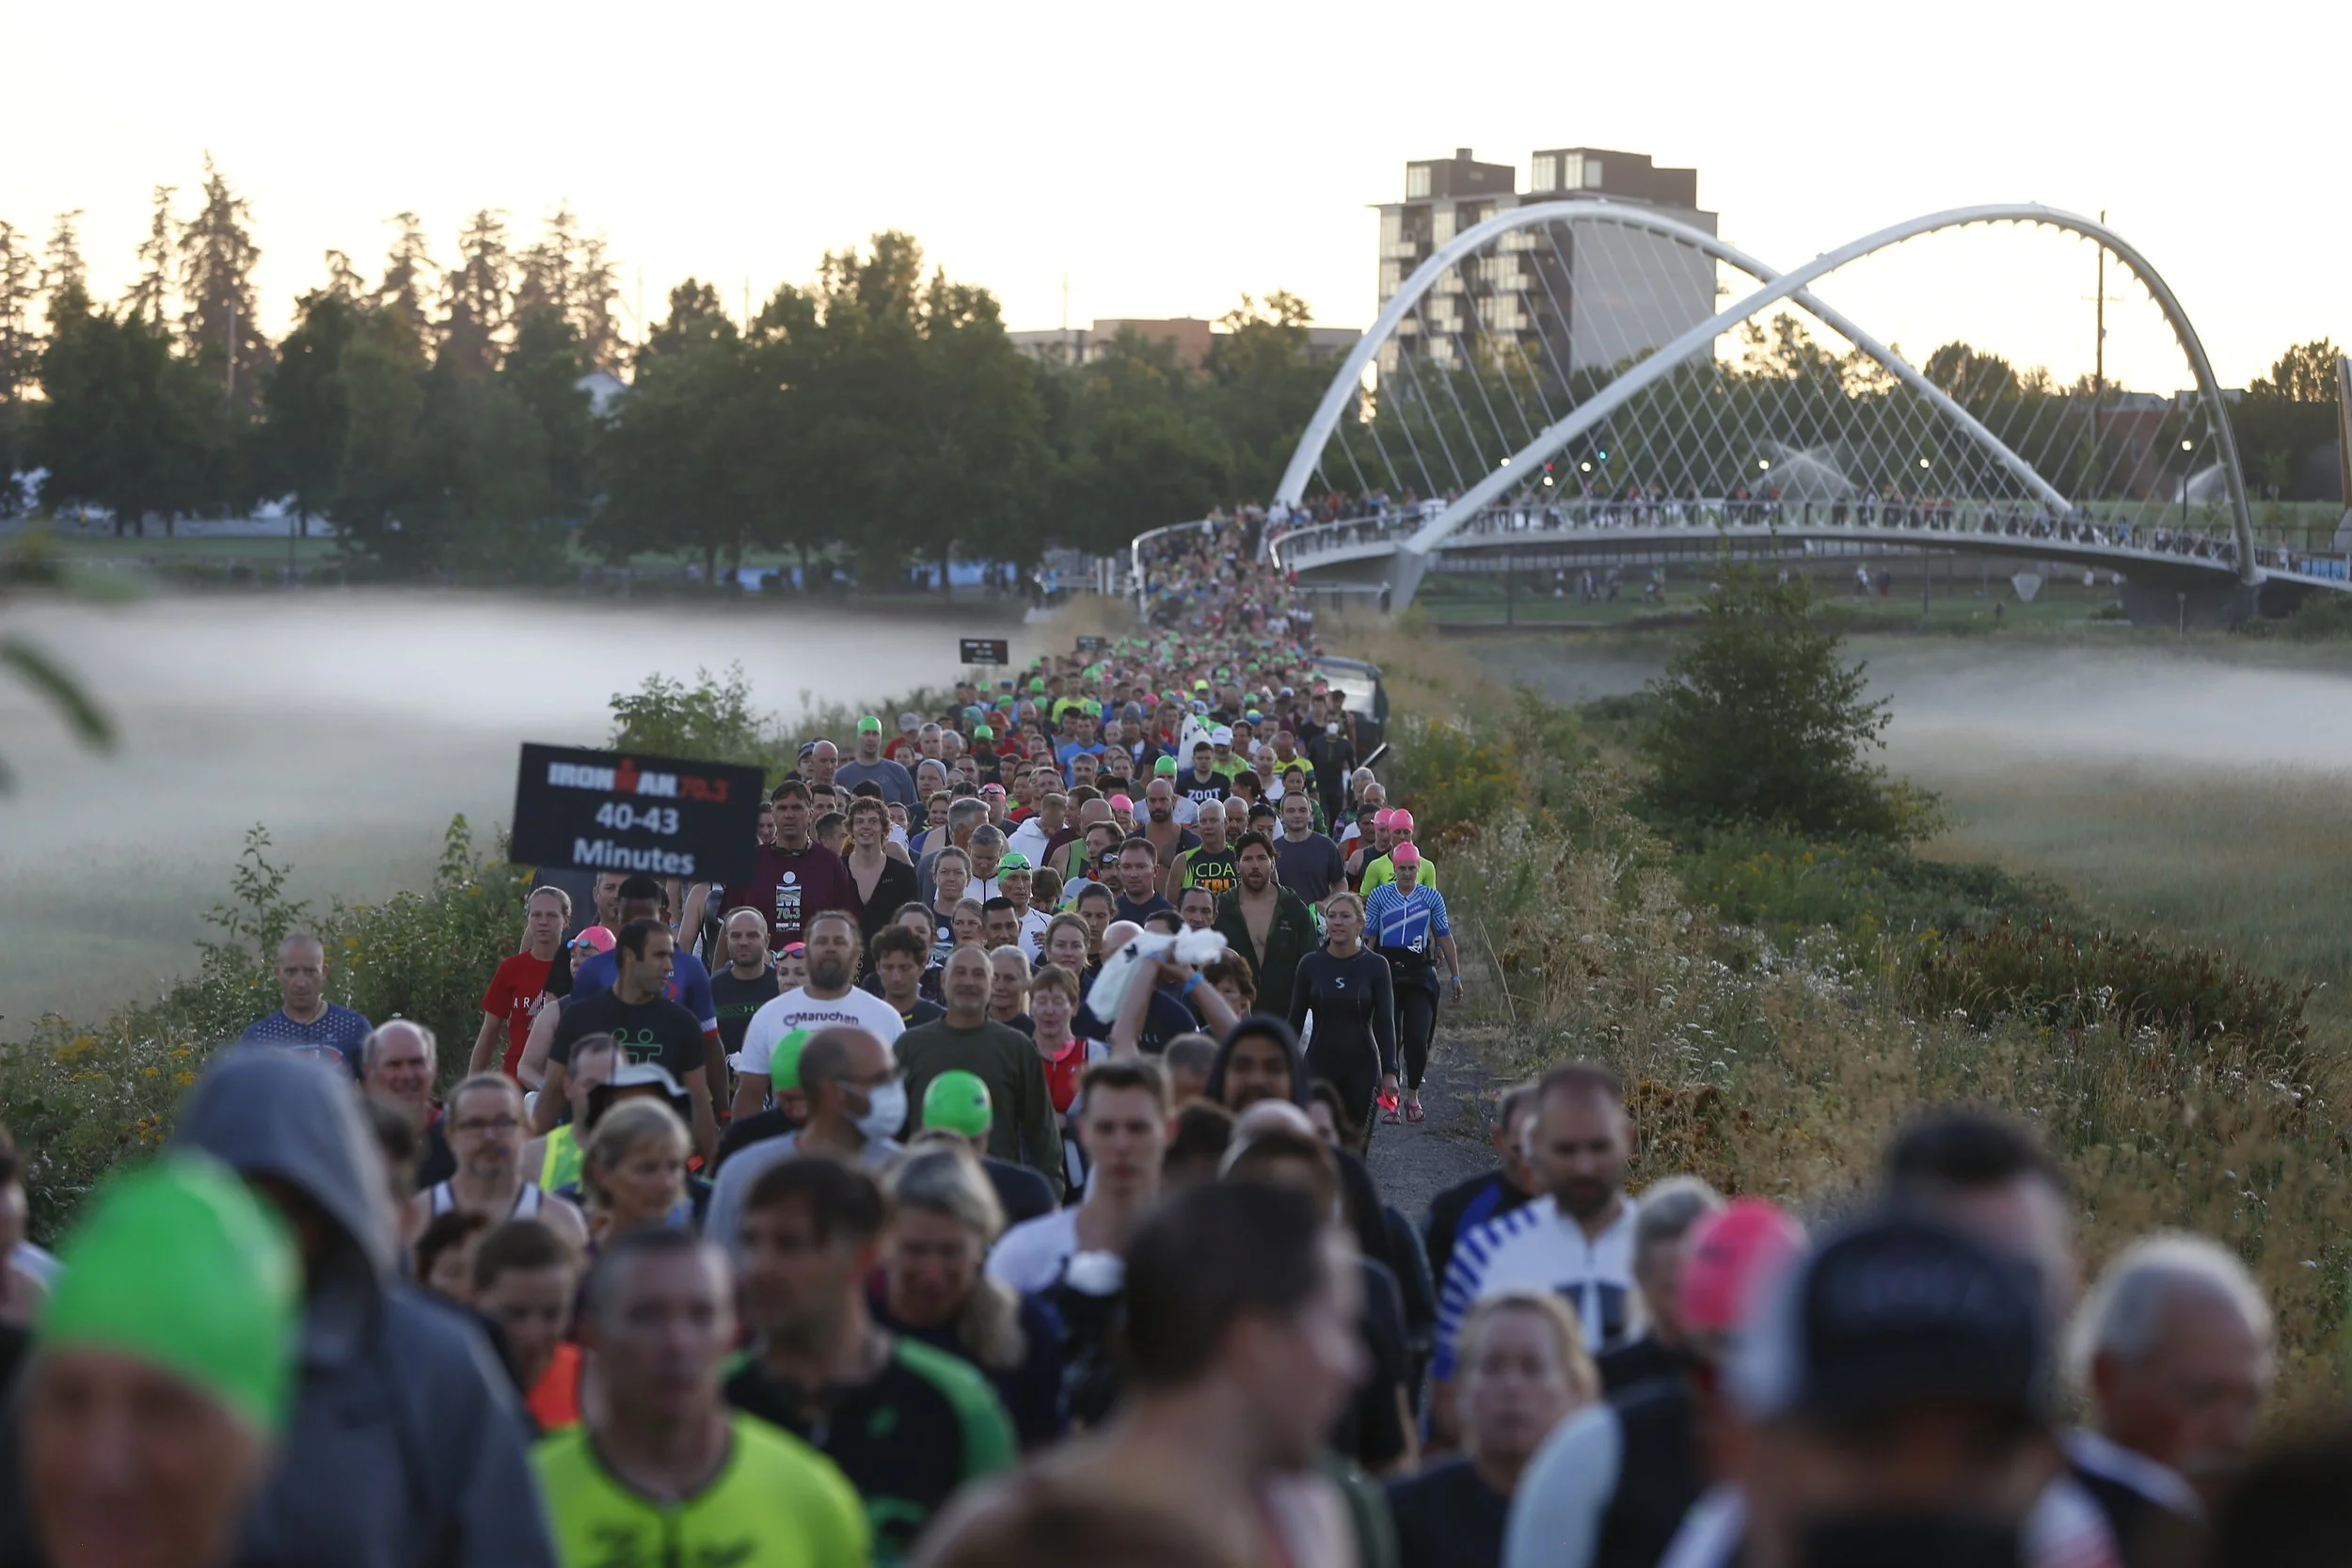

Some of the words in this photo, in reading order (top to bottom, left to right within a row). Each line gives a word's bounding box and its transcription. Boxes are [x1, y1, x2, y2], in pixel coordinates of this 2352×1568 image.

[680, 775, 730, 802] 70.3
[1187, 787, 1220, 801] ZOOT
[596, 801, 680, 834] 40-43
[573, 836, 696, 876] Minutes
[1196, 862, 1236, 878] CDA
[776, 907, 801, 919] 70.3
[796, 1009, 860, 1026] Maruchan
